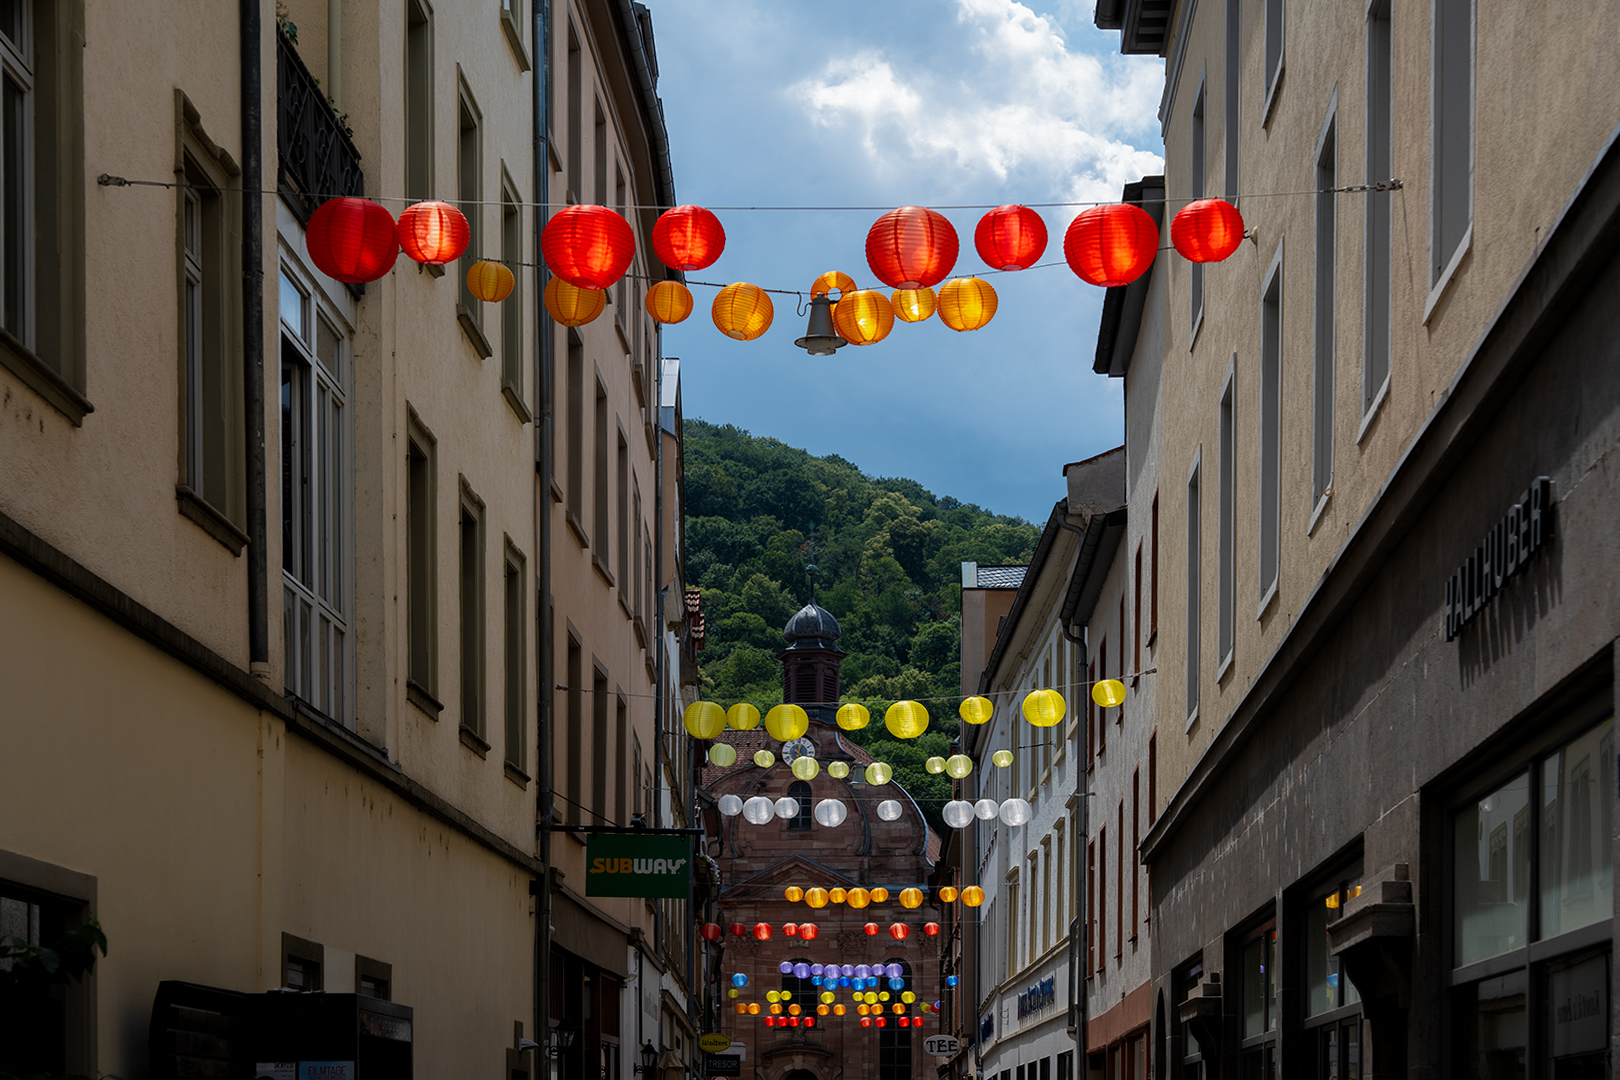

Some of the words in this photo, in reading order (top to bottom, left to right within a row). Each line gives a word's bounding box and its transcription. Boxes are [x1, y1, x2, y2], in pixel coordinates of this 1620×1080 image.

[1445, 476, 1550, 642] HALLHUBER
[589, 857, 687, 875] SUBWAY
[926, 1040, 957, 1052] TEE
[708, 1060, 738, 1068] TRESOR
[308, 1066, 346, 1075] FILMTAGE
